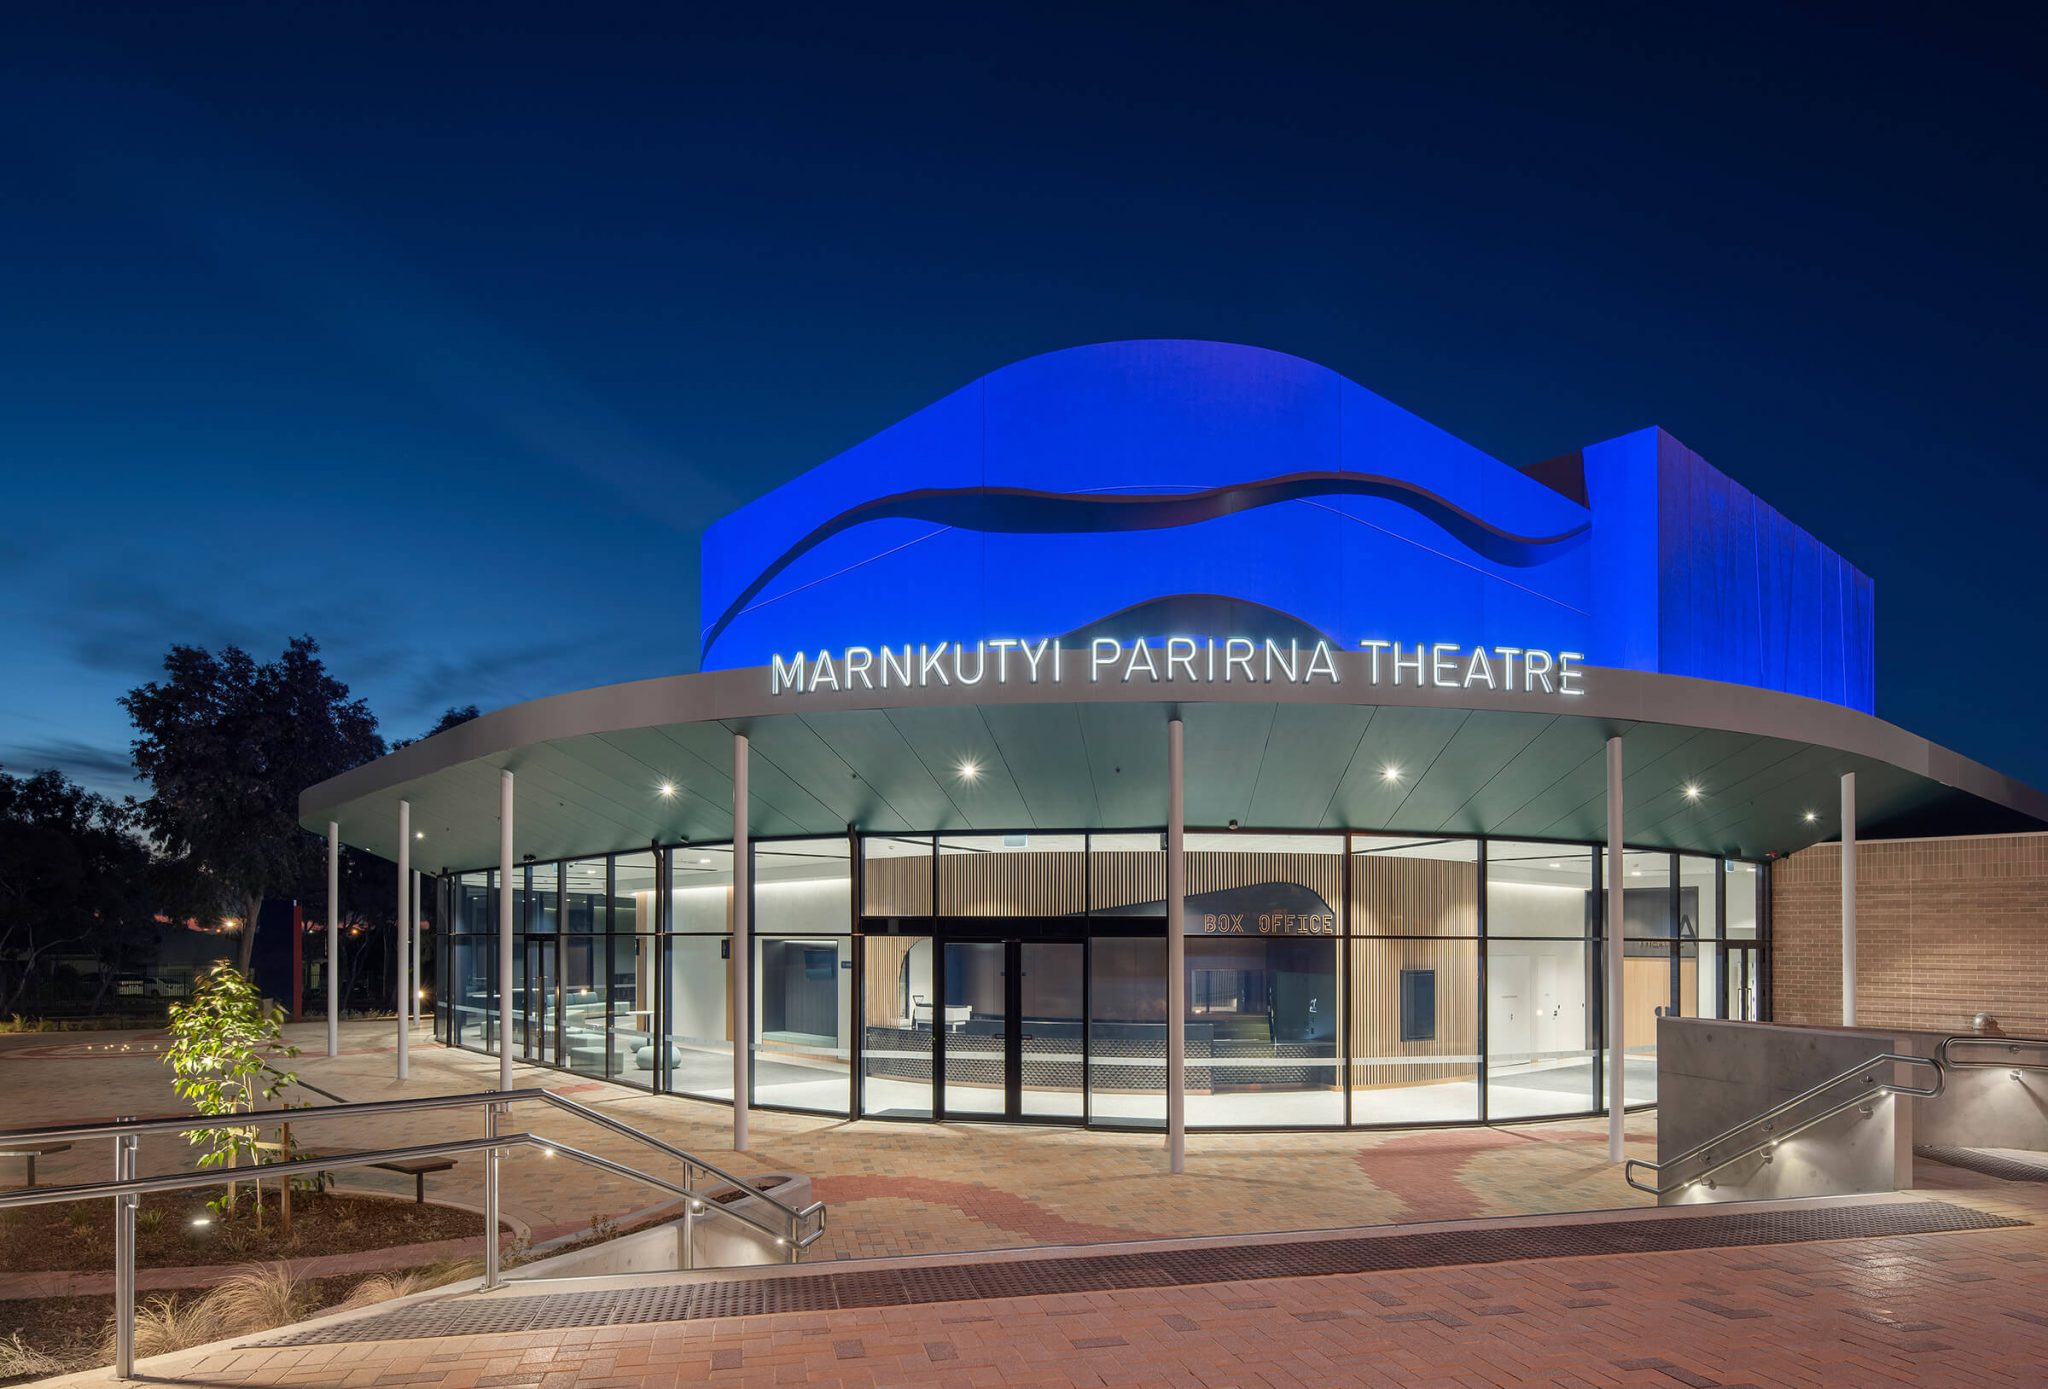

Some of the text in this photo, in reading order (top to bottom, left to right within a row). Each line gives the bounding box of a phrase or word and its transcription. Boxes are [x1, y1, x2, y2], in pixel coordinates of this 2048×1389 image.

[771, 635, 1586, 696] MARNKUTYI PARIRNA THEATRE
[1204, 913, 1333, 935] BOX OFFICE
